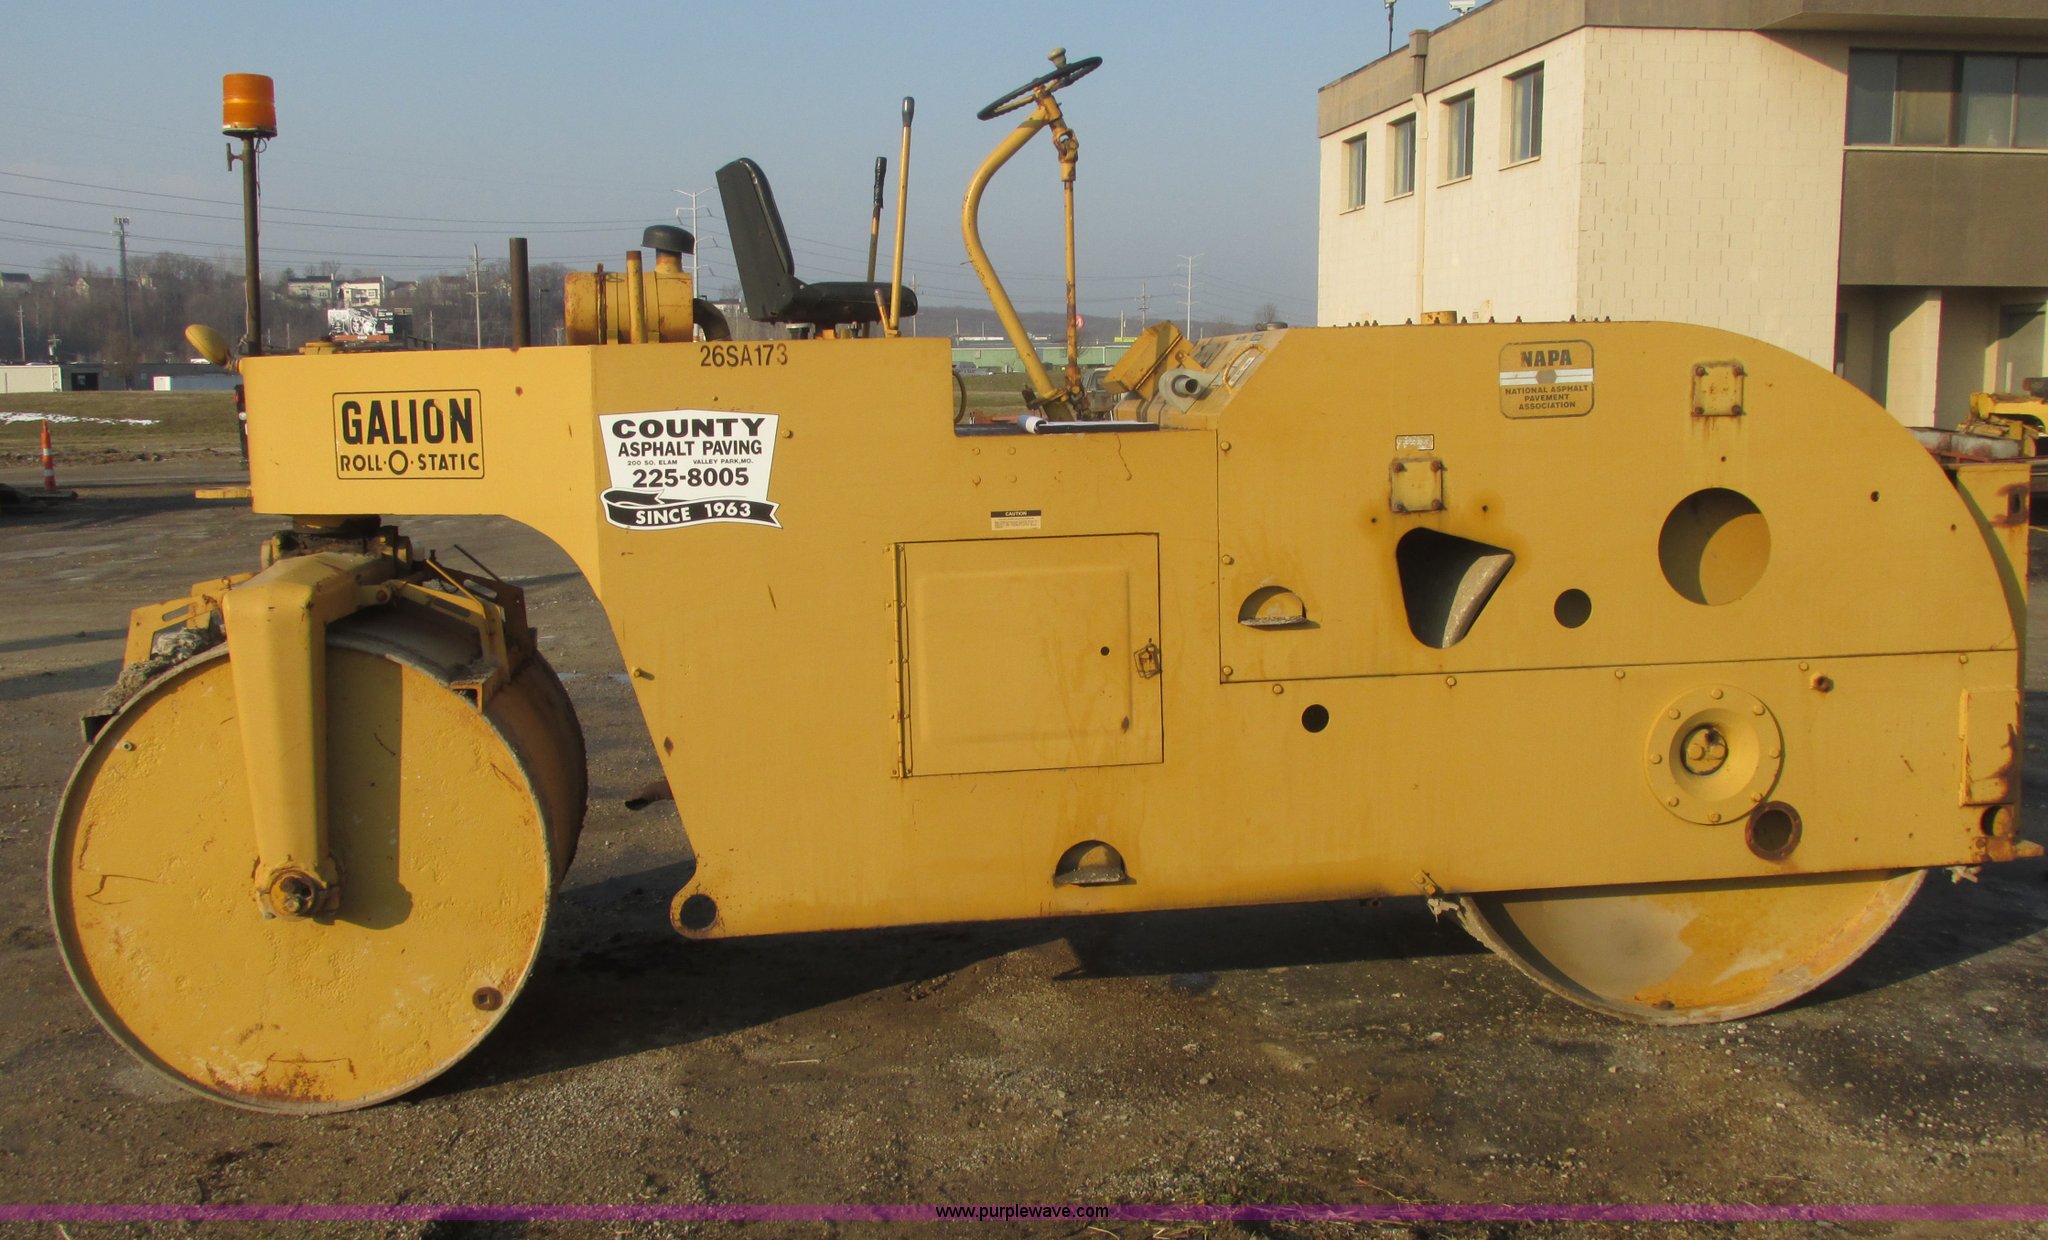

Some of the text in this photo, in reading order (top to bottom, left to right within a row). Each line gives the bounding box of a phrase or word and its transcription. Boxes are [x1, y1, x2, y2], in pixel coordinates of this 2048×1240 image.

[700, 343, 788, 367] 26SA173
[1521, 349, 1572, 367] NAPA
[341, 398, 474, 445] GALION
[612, 417, 766, 439] COUNTY
[618, 440, 762, 457] ASPHALT PAVING
[632, 467, 749, 488] 225-8005
[635, 502, 751, 525] SINCE 1963
